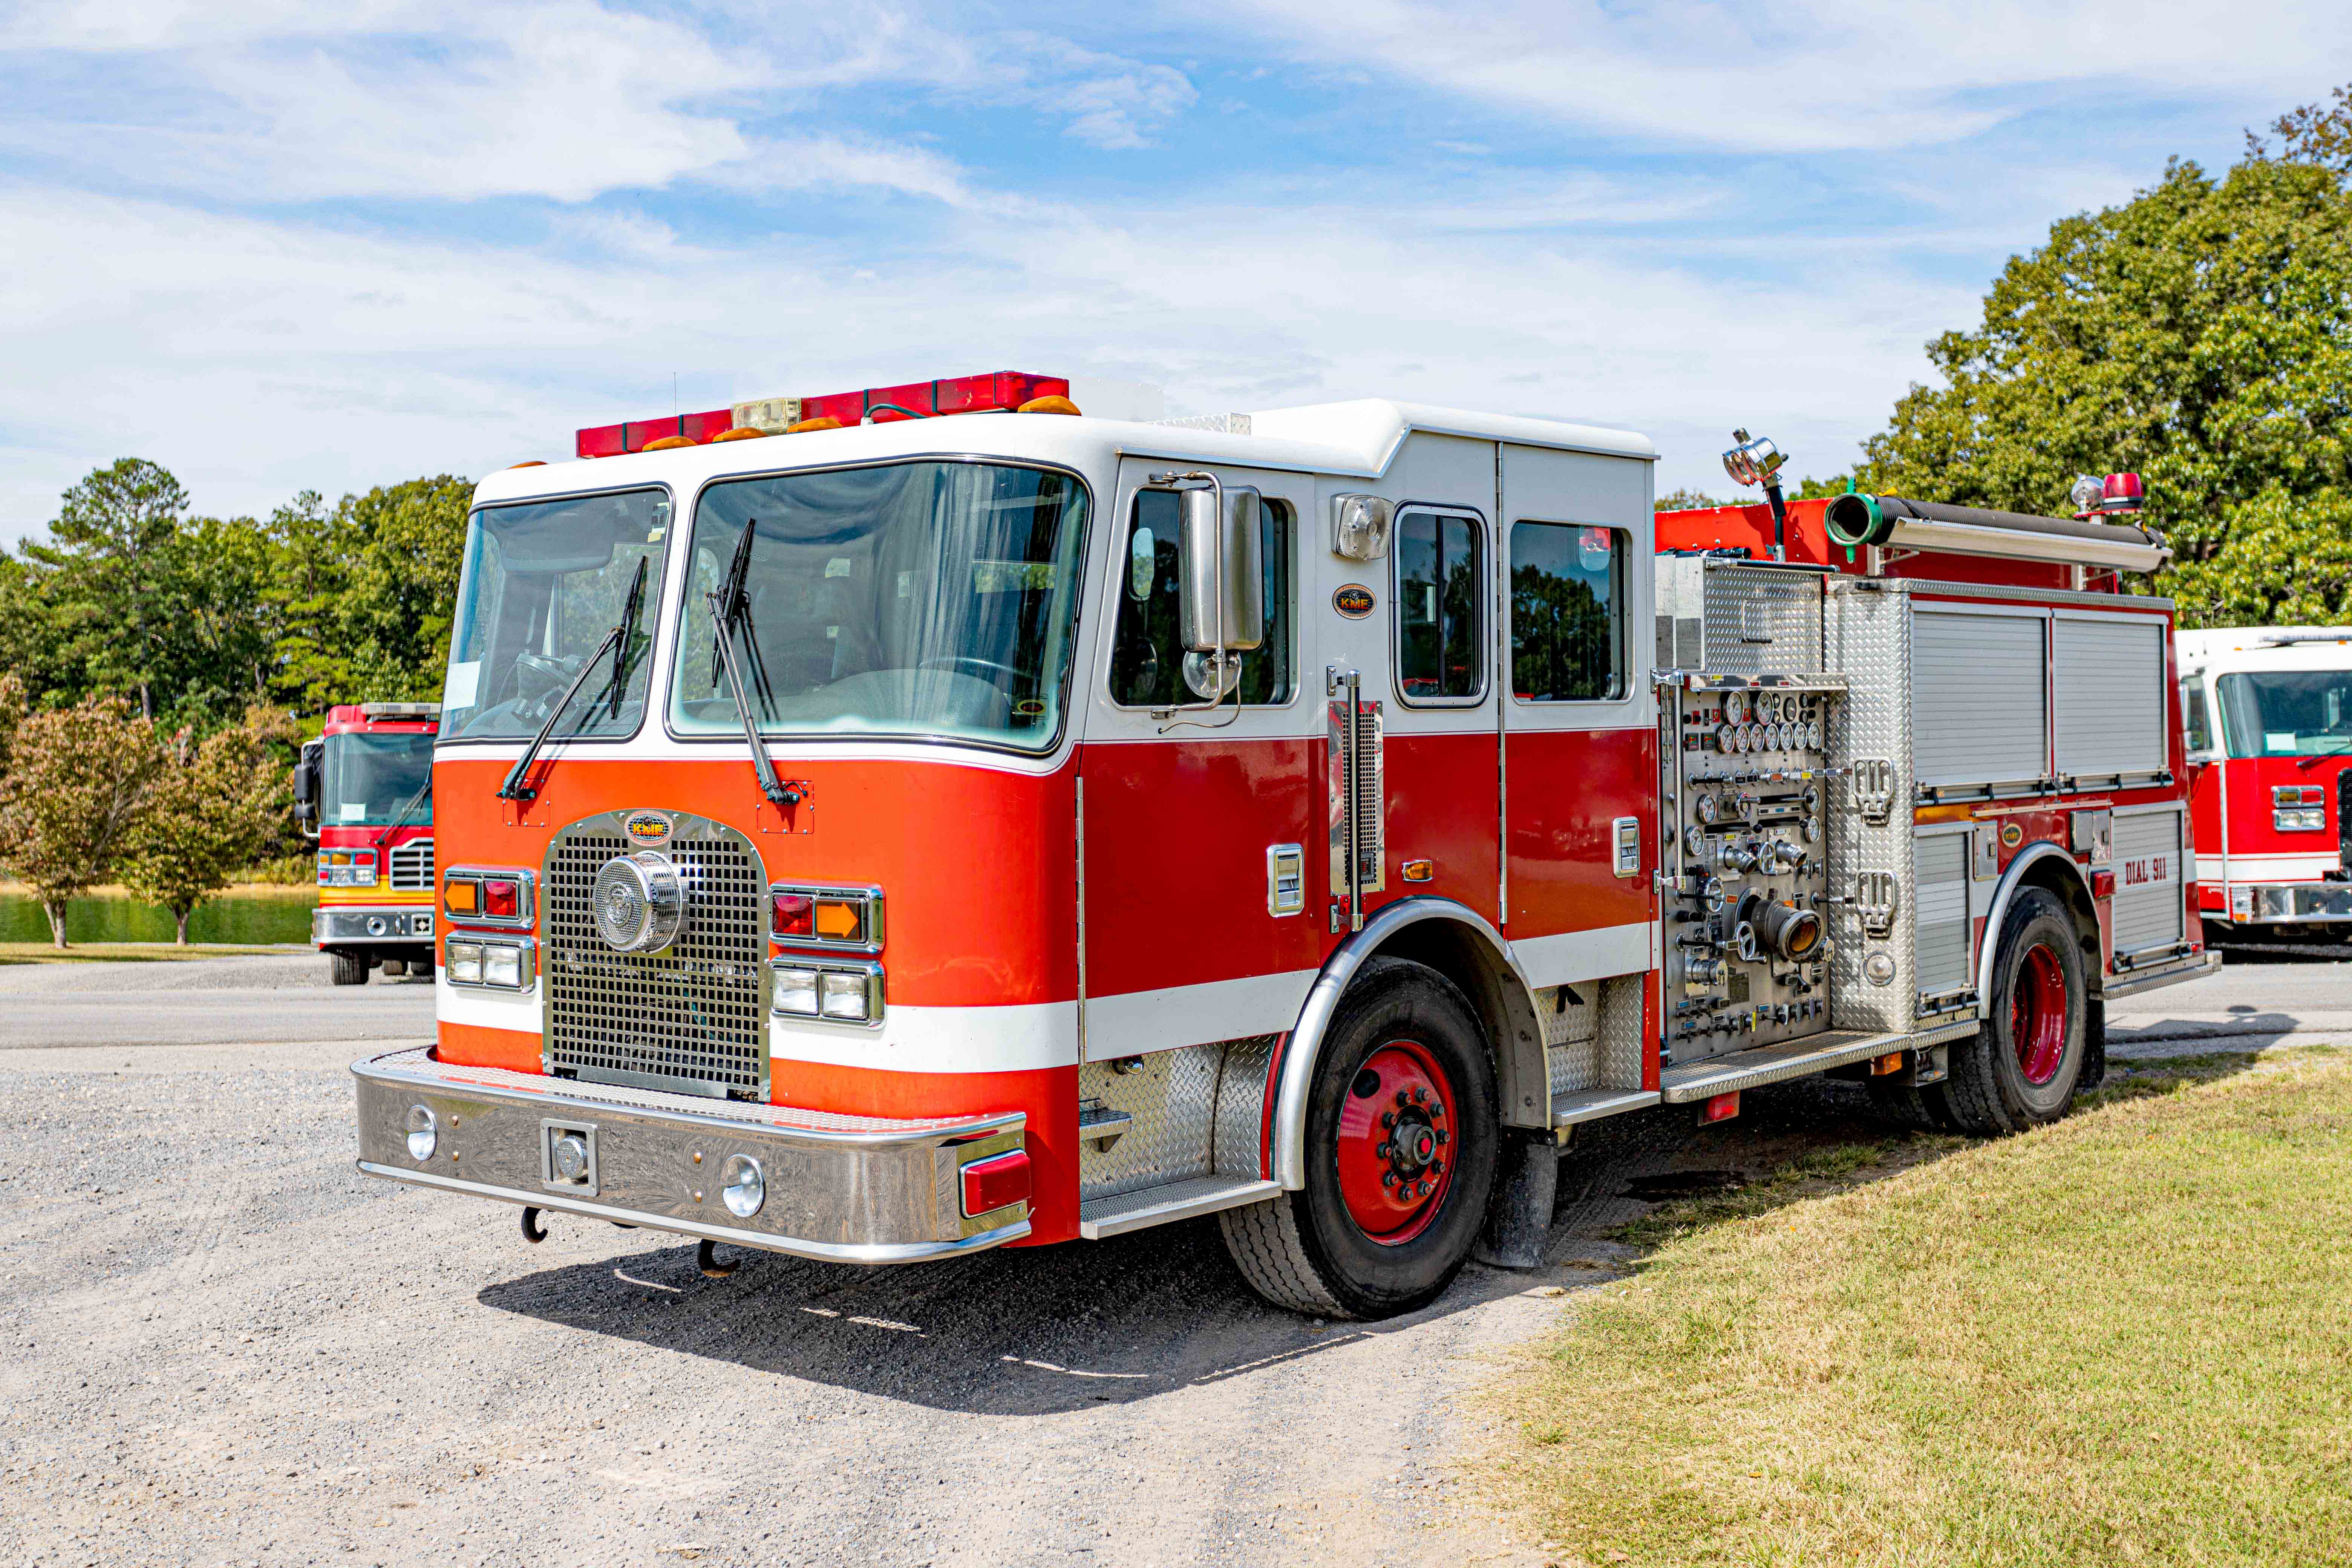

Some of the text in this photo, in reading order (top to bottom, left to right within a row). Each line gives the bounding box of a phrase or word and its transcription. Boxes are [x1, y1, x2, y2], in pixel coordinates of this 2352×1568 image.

[1341, 597, 1369, 609] KME
[633, 823, 664, 836] KME
[2125, 856, 2167, 885] DIAL 911
